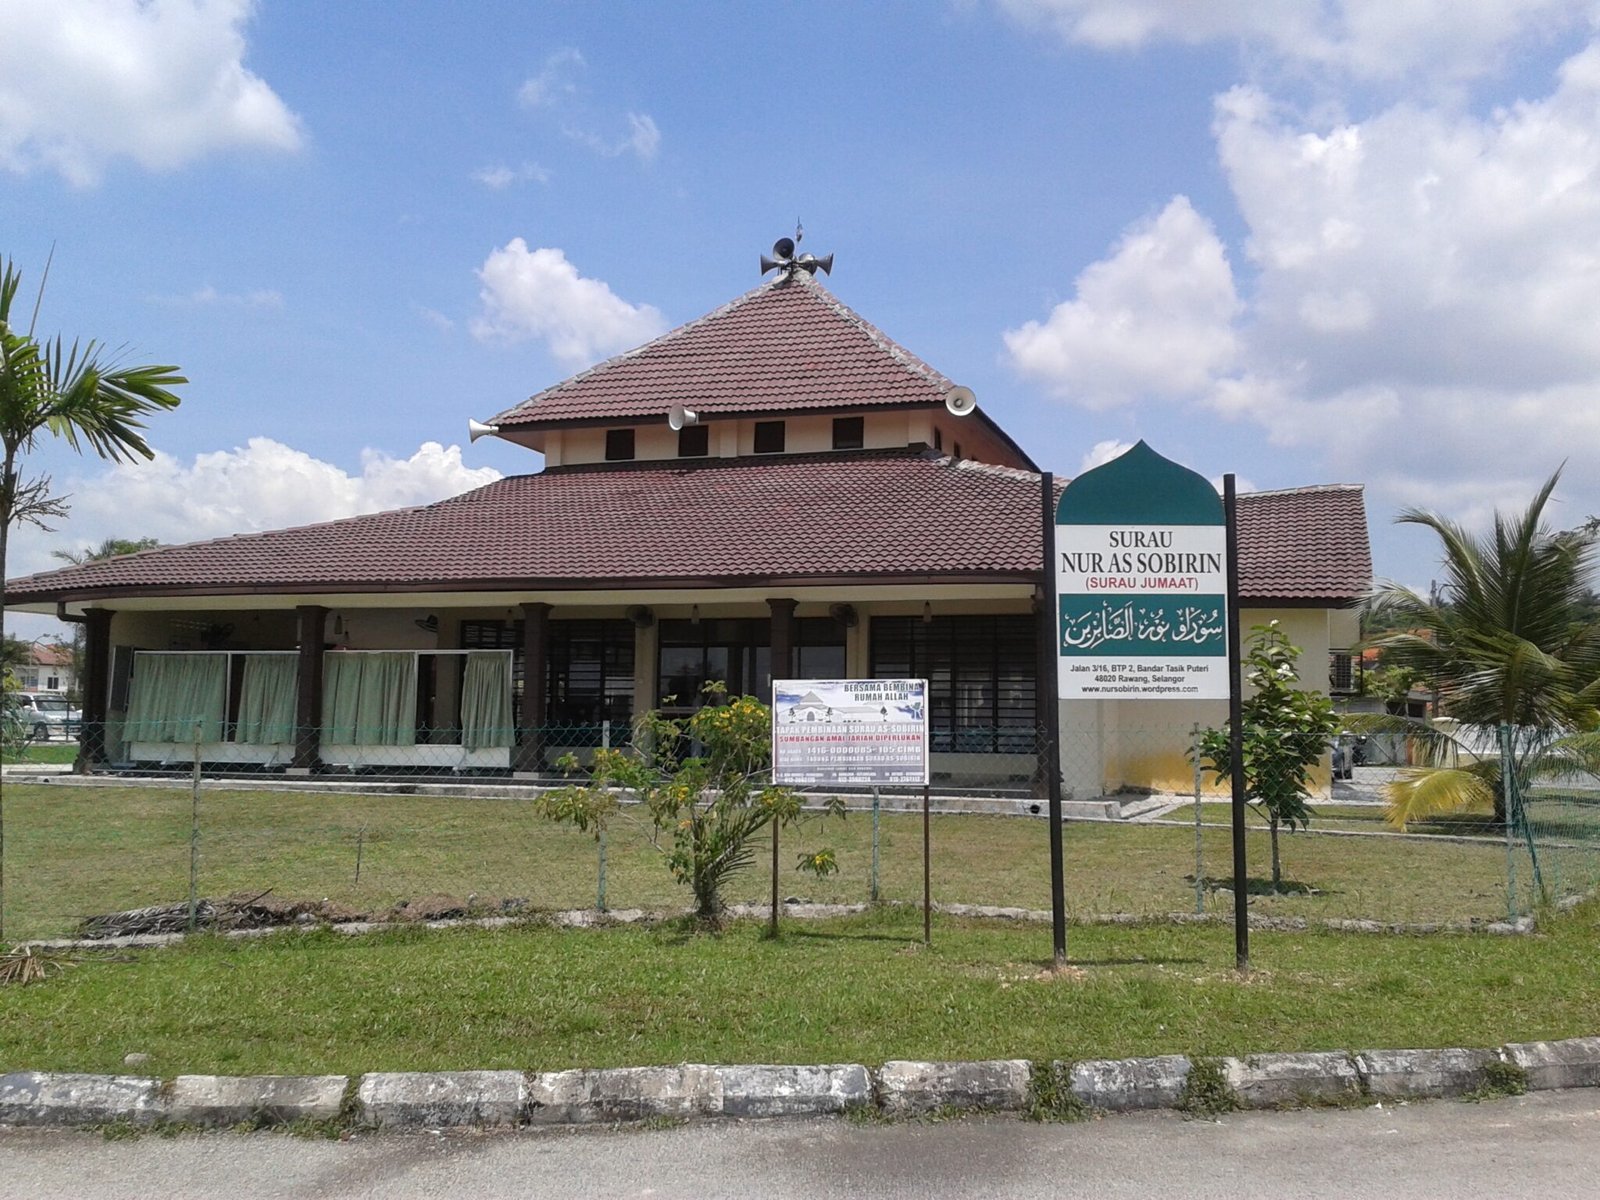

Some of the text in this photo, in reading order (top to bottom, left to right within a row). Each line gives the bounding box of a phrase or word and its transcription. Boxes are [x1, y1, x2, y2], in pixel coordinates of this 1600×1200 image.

[1109, 530, 1173, 549] SURAU
[1061, 552, 1222, 574] NUR AS SOBIRIN
[1085, 577, 1199, 591] (SURAU JUMAAT)
[1070, 664, 1209, 674] Jalan 3/16, BTP 2, Bandar Tasik Puteri
[1094, 675, 1185, 685] 48020 Rawang, Selangor
[844, 683, 881, 692] BERSAMA
[1082, 685, 1199, 695] www.nursobirin.wordpress.com
[854, 692, 909, 701] RUMAH ALLAH
[776, 724, 924, 734] TAPAK PEMBINAAN SURAU AS-SOBIRIN
